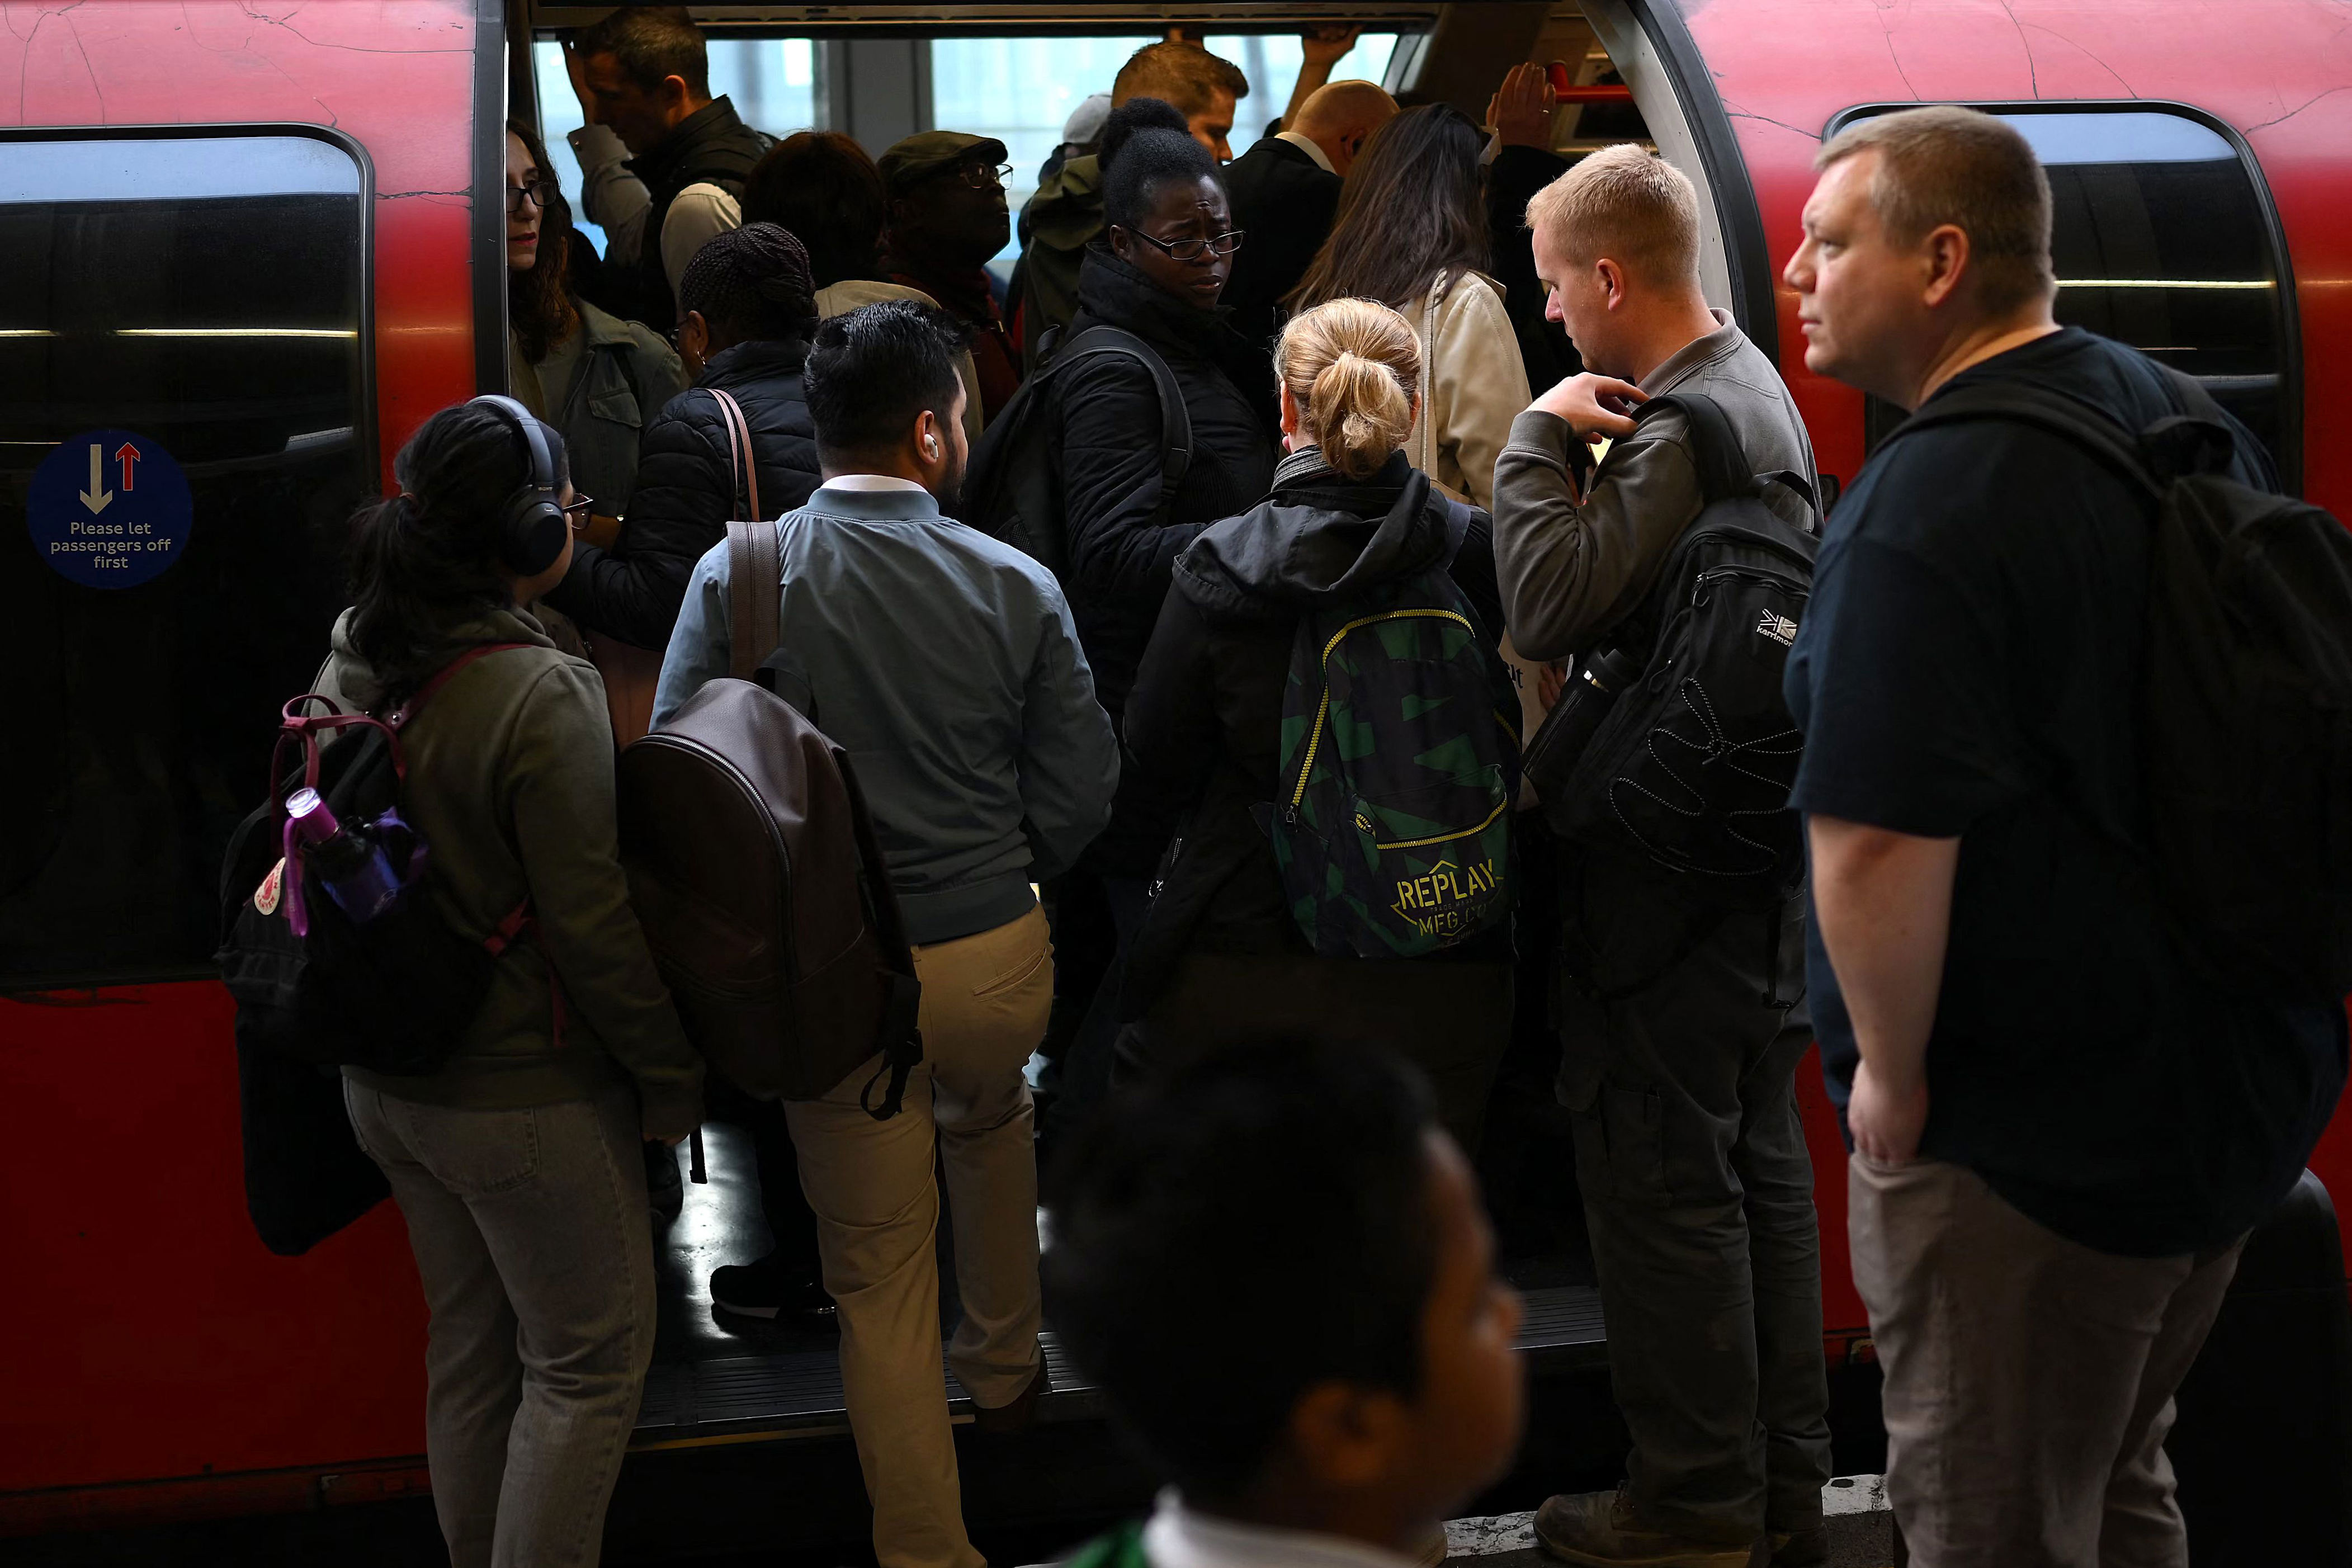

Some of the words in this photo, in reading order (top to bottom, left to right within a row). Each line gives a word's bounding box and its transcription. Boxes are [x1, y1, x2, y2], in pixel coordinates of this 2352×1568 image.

[70, 522, 123, 535] Please
[128, 522, 152, 535] let
[50, 541, 141, 555] passengers
[147, 539, 172, 551] off
[93, 556, 129, 568] first
[1756, 625, 1793, 647] karrimor
[1396, 858, 1496, 910] REPLAY
